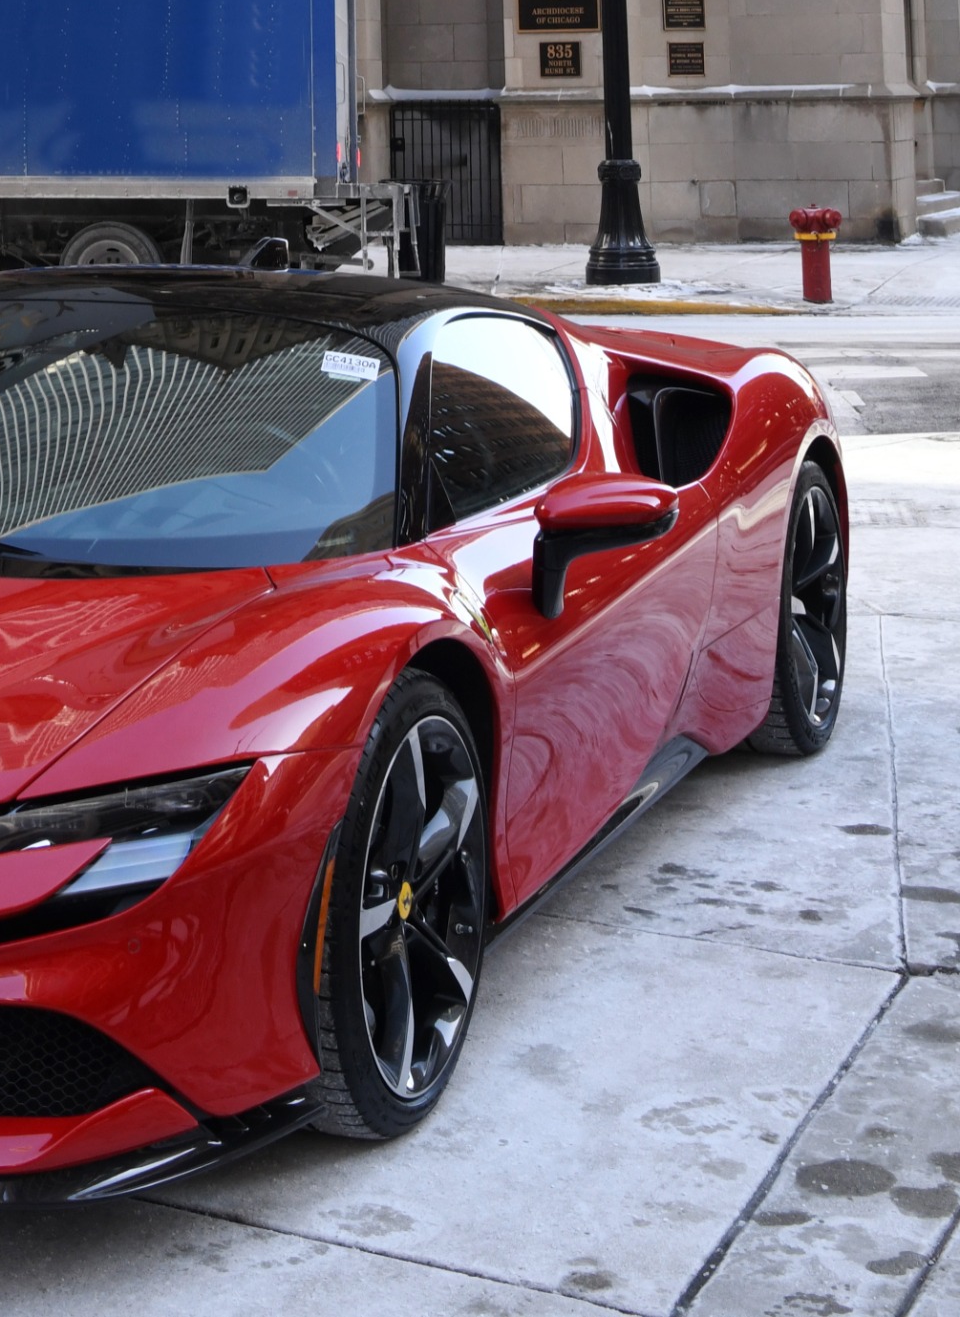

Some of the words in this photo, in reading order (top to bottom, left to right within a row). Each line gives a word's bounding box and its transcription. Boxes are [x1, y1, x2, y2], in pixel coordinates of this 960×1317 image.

[532, 7, 584, 15] ARCHDIOCESE
[547, 16, 580, 24] CHICAGO
[547, 44, 573, 59] 835
[548, 59, 572, 67] NORTH
